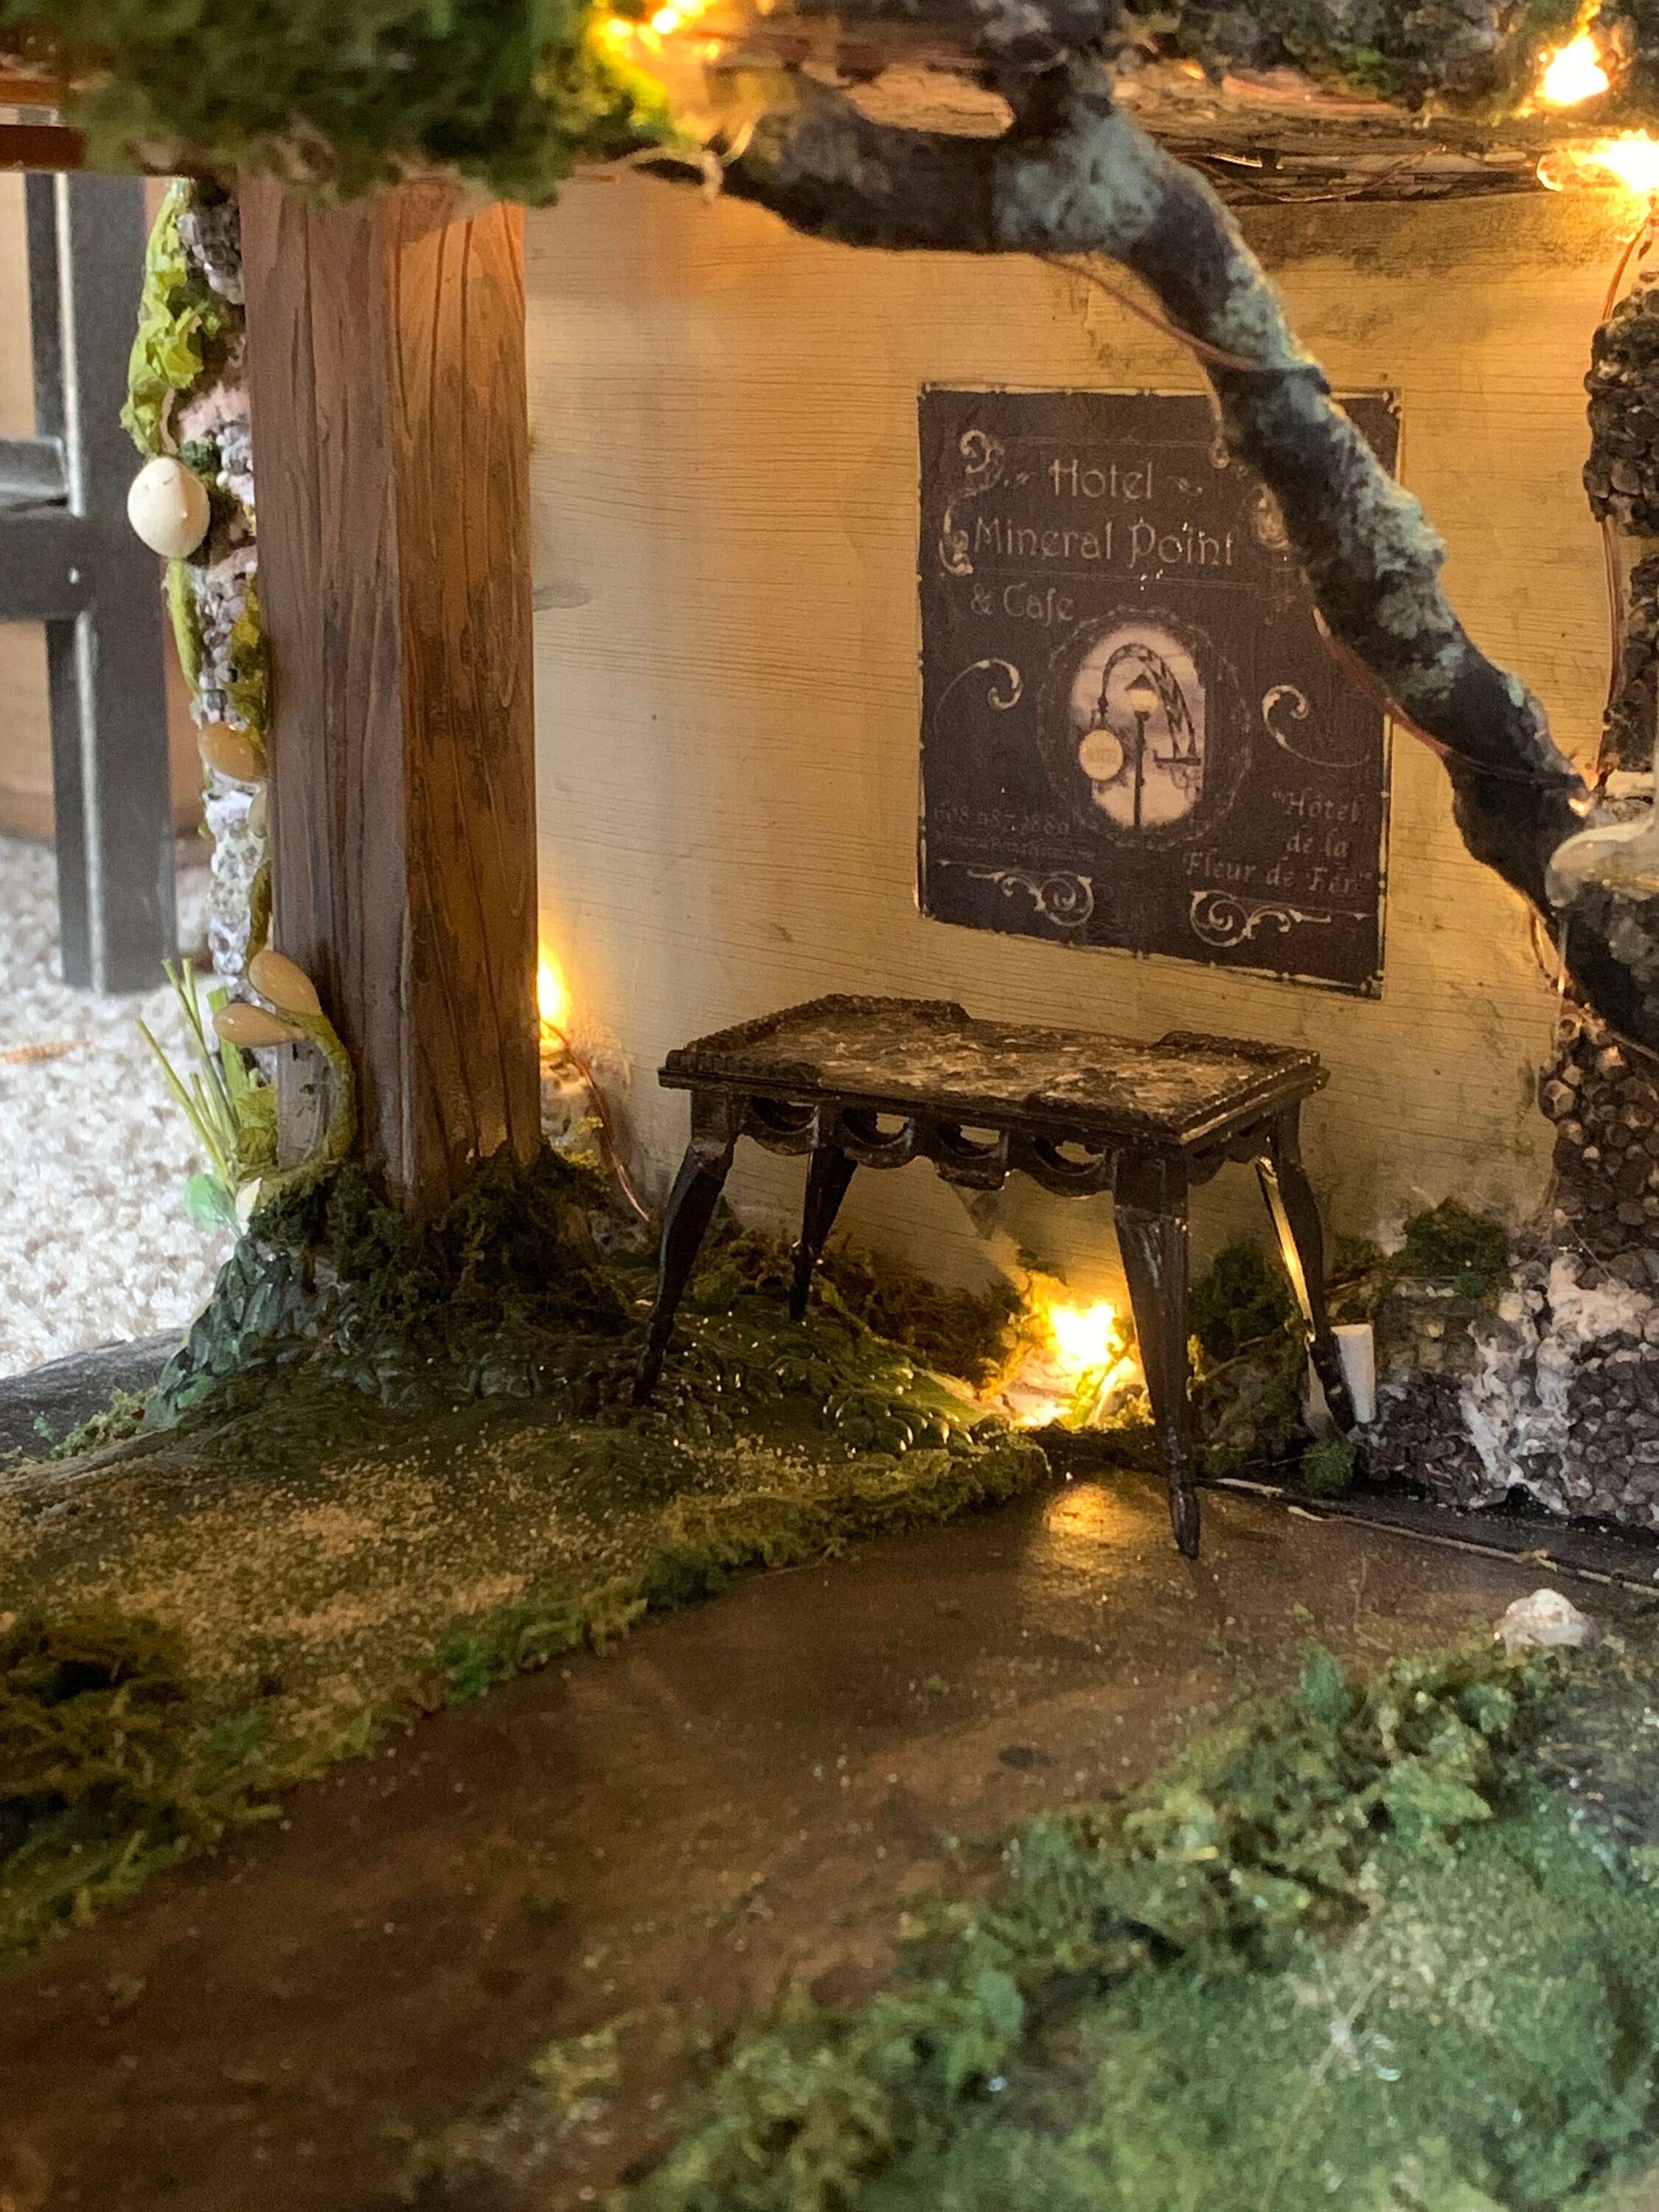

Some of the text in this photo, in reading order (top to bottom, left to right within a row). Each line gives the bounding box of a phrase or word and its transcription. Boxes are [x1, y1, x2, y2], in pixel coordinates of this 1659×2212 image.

[1049, 459, 1153, 499] Hotel
[973, 516, 1234, 568] Mineral Point
[970, 581, 993, 615] &
